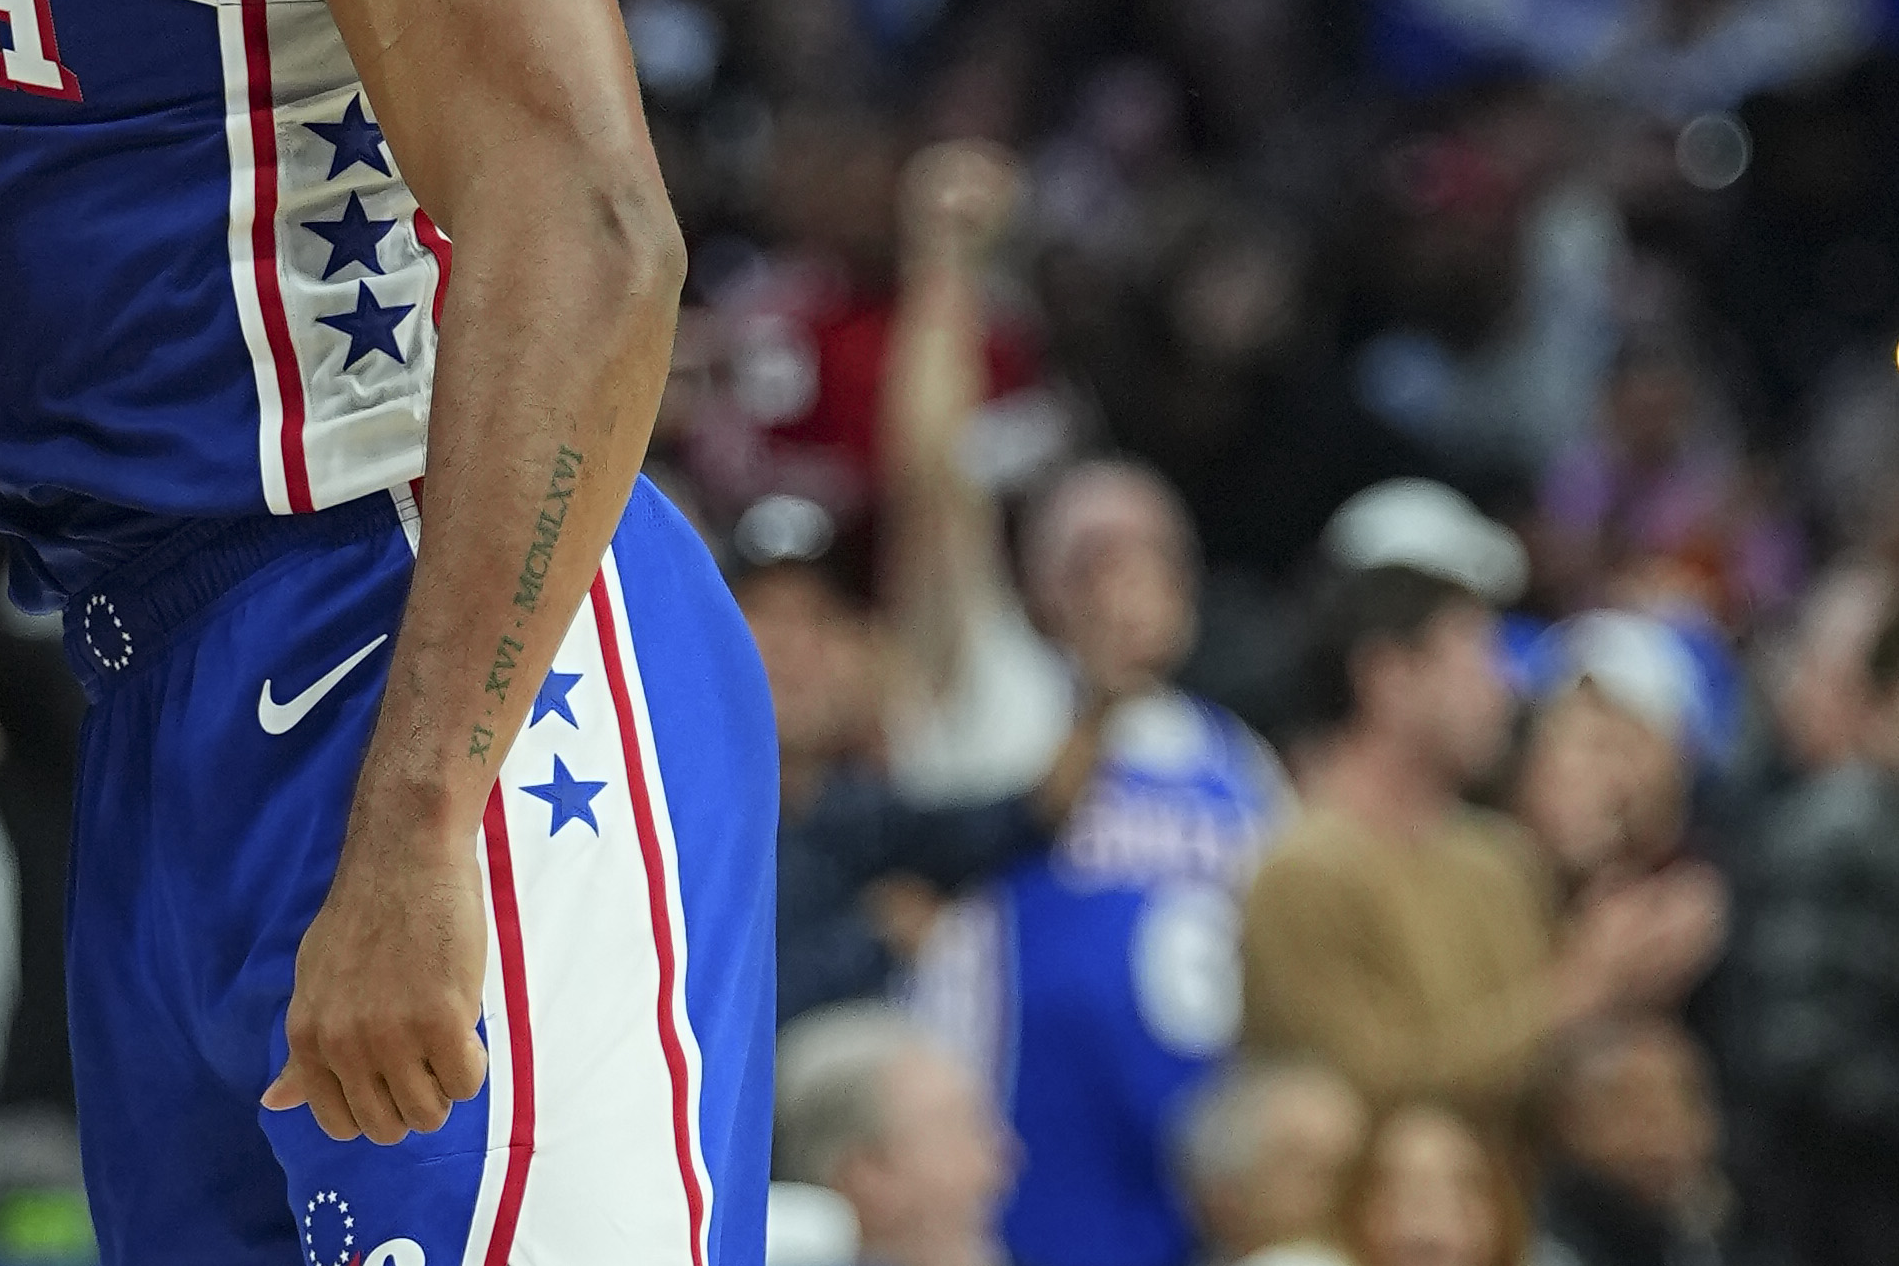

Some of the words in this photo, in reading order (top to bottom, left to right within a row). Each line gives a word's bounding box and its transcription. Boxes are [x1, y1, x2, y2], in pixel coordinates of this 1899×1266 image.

[469, 724, 494, 765] XI
[486, 635, 524, 704] XVI
[514, 444, 583, 612] MCMLXVI
